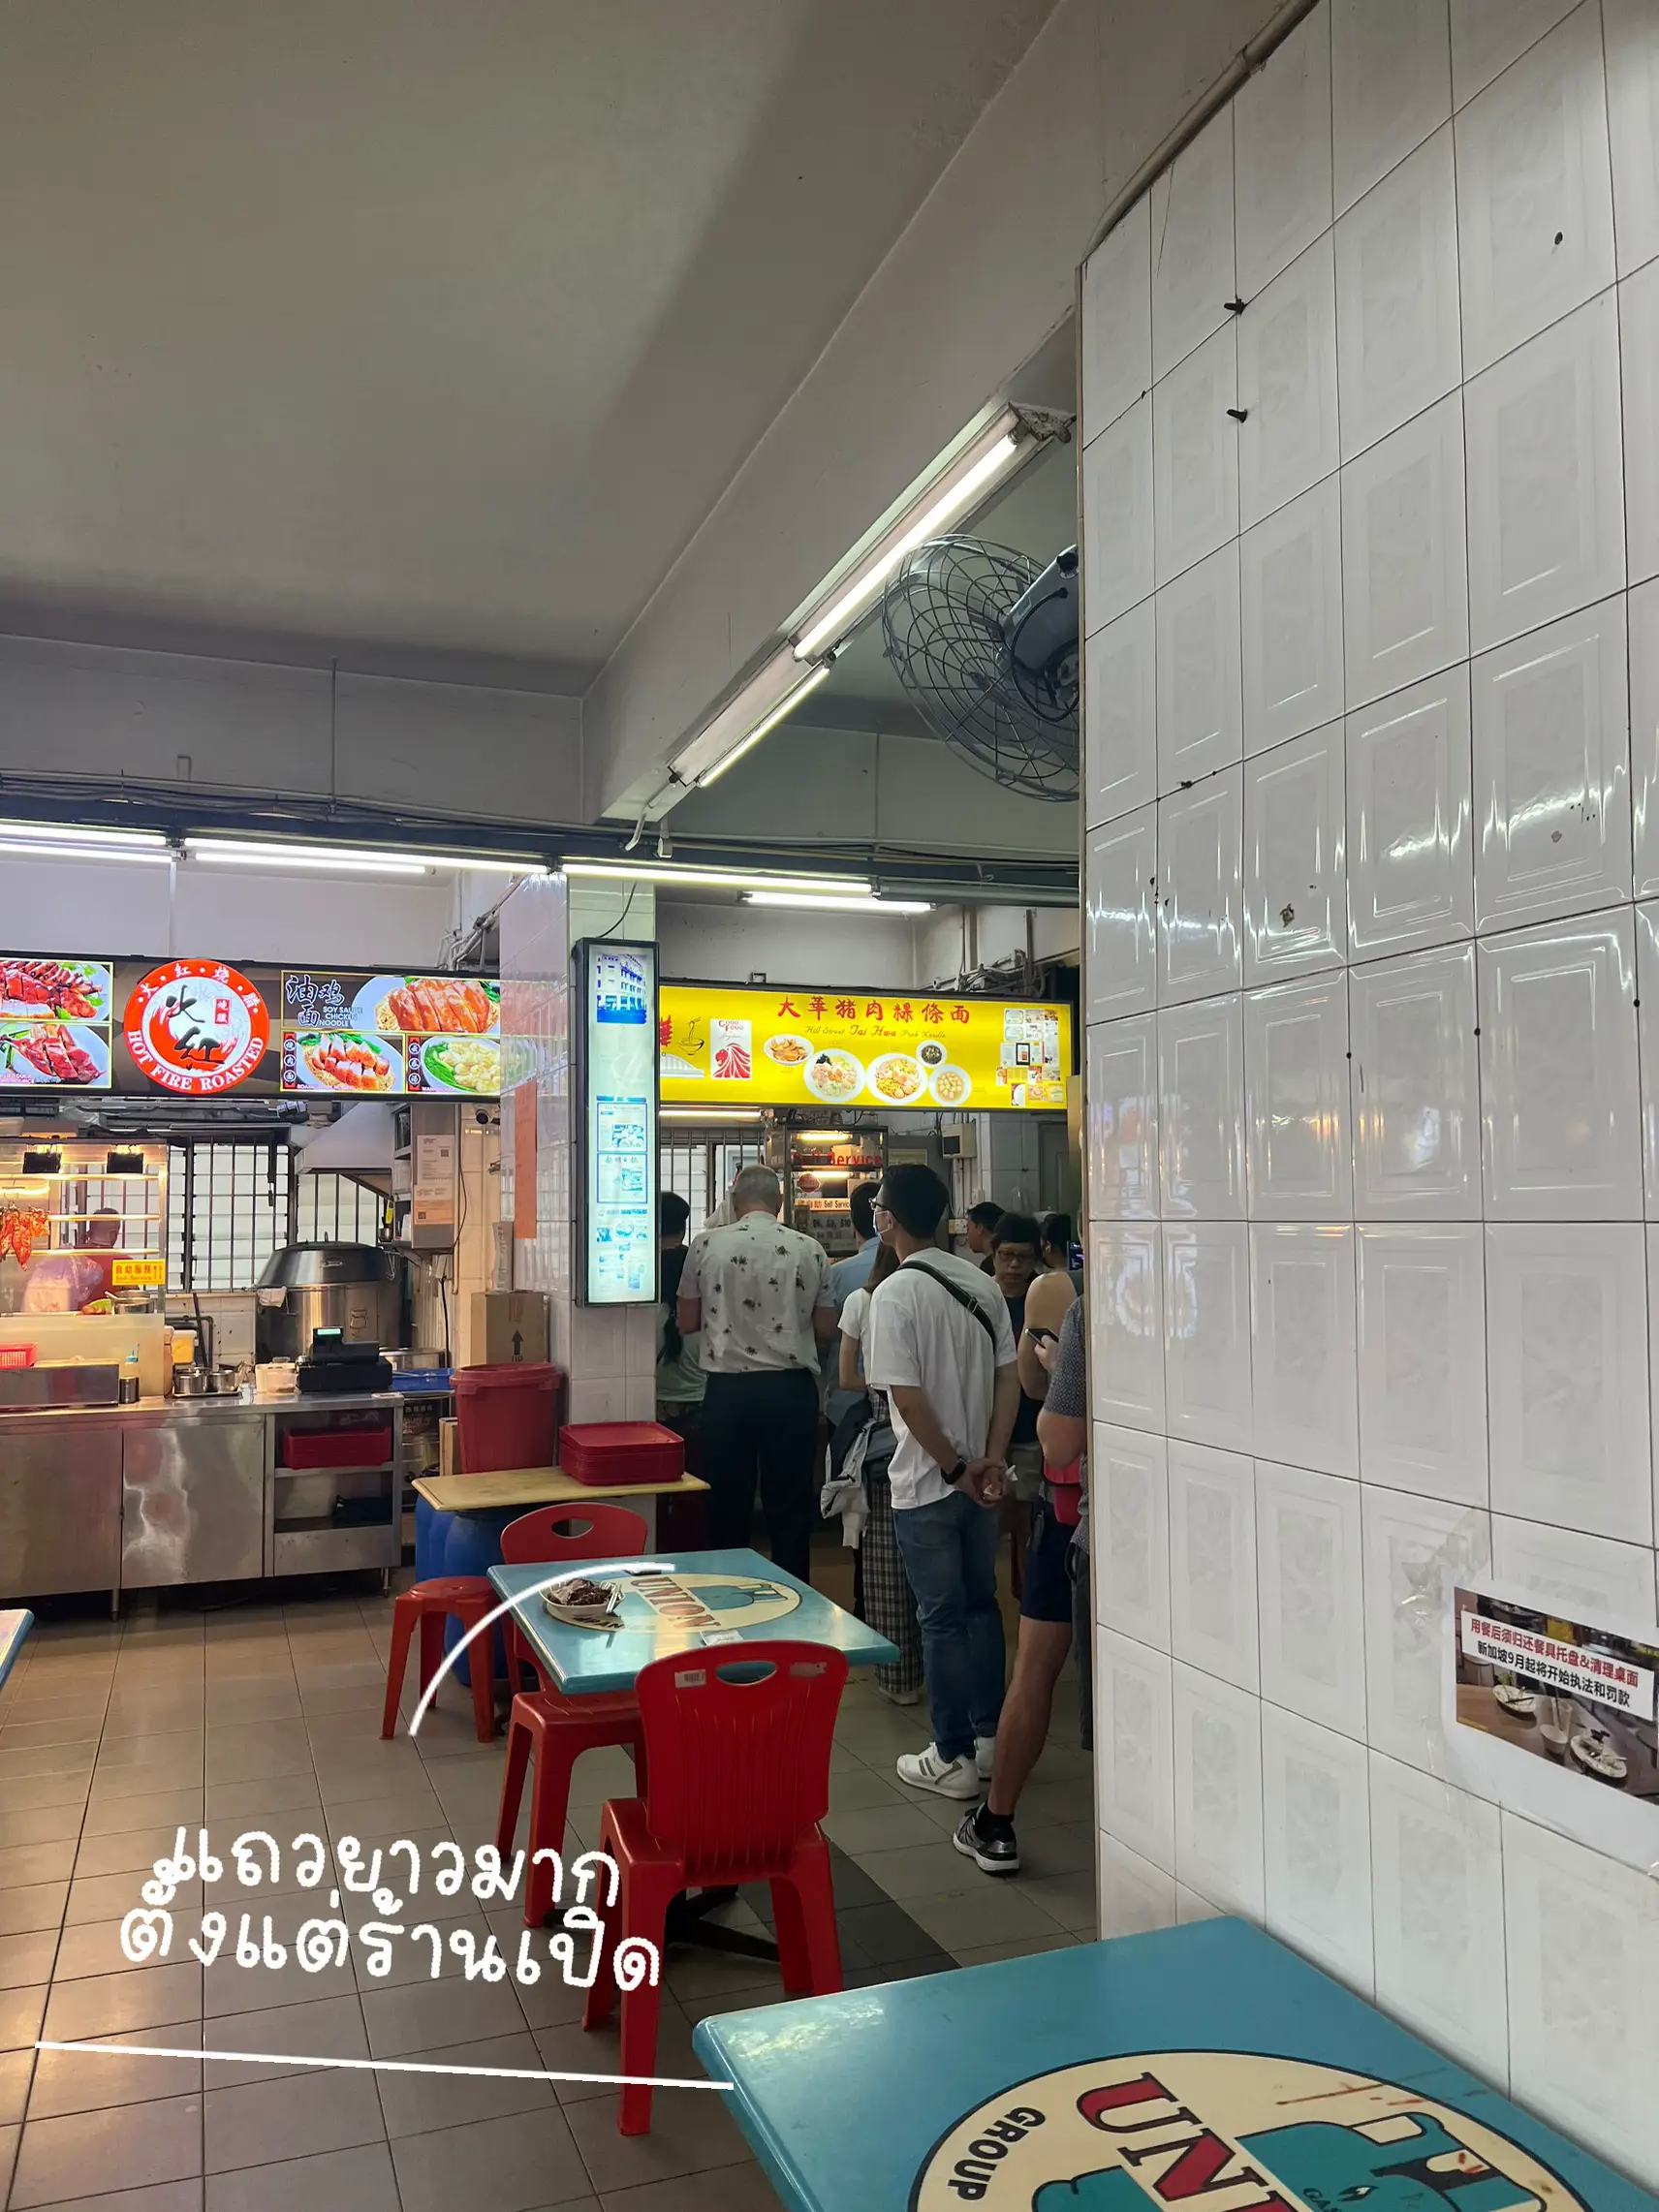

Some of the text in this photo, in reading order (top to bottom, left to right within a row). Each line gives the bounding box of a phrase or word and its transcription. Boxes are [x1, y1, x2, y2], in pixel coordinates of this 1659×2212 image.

[325, 1013, 358, 1021] CHICKEN
[804, 1025, 821, 1034] Hill
[822, 1027, 845, 1036] Street
[849, 1025, 868, 1036] Tai
[870, 1025, 896, 1037] Hwa
[900, 1030, 920, 1039] Pork
[128, 1030, 264, 1091] HOT FIRE ROASTED
[834, 1199, 850, 1208] Servic
[630, 1575, 722, 1630] UNION
[1470, 1617, 1640, 1689] 用餐后须归还餐具托盘&清理桌面
[1477, 1640, 1632, 1708] 新加坡9月起将开始执法和罚款
[948, 2105, 1047, 2201] GROUP
